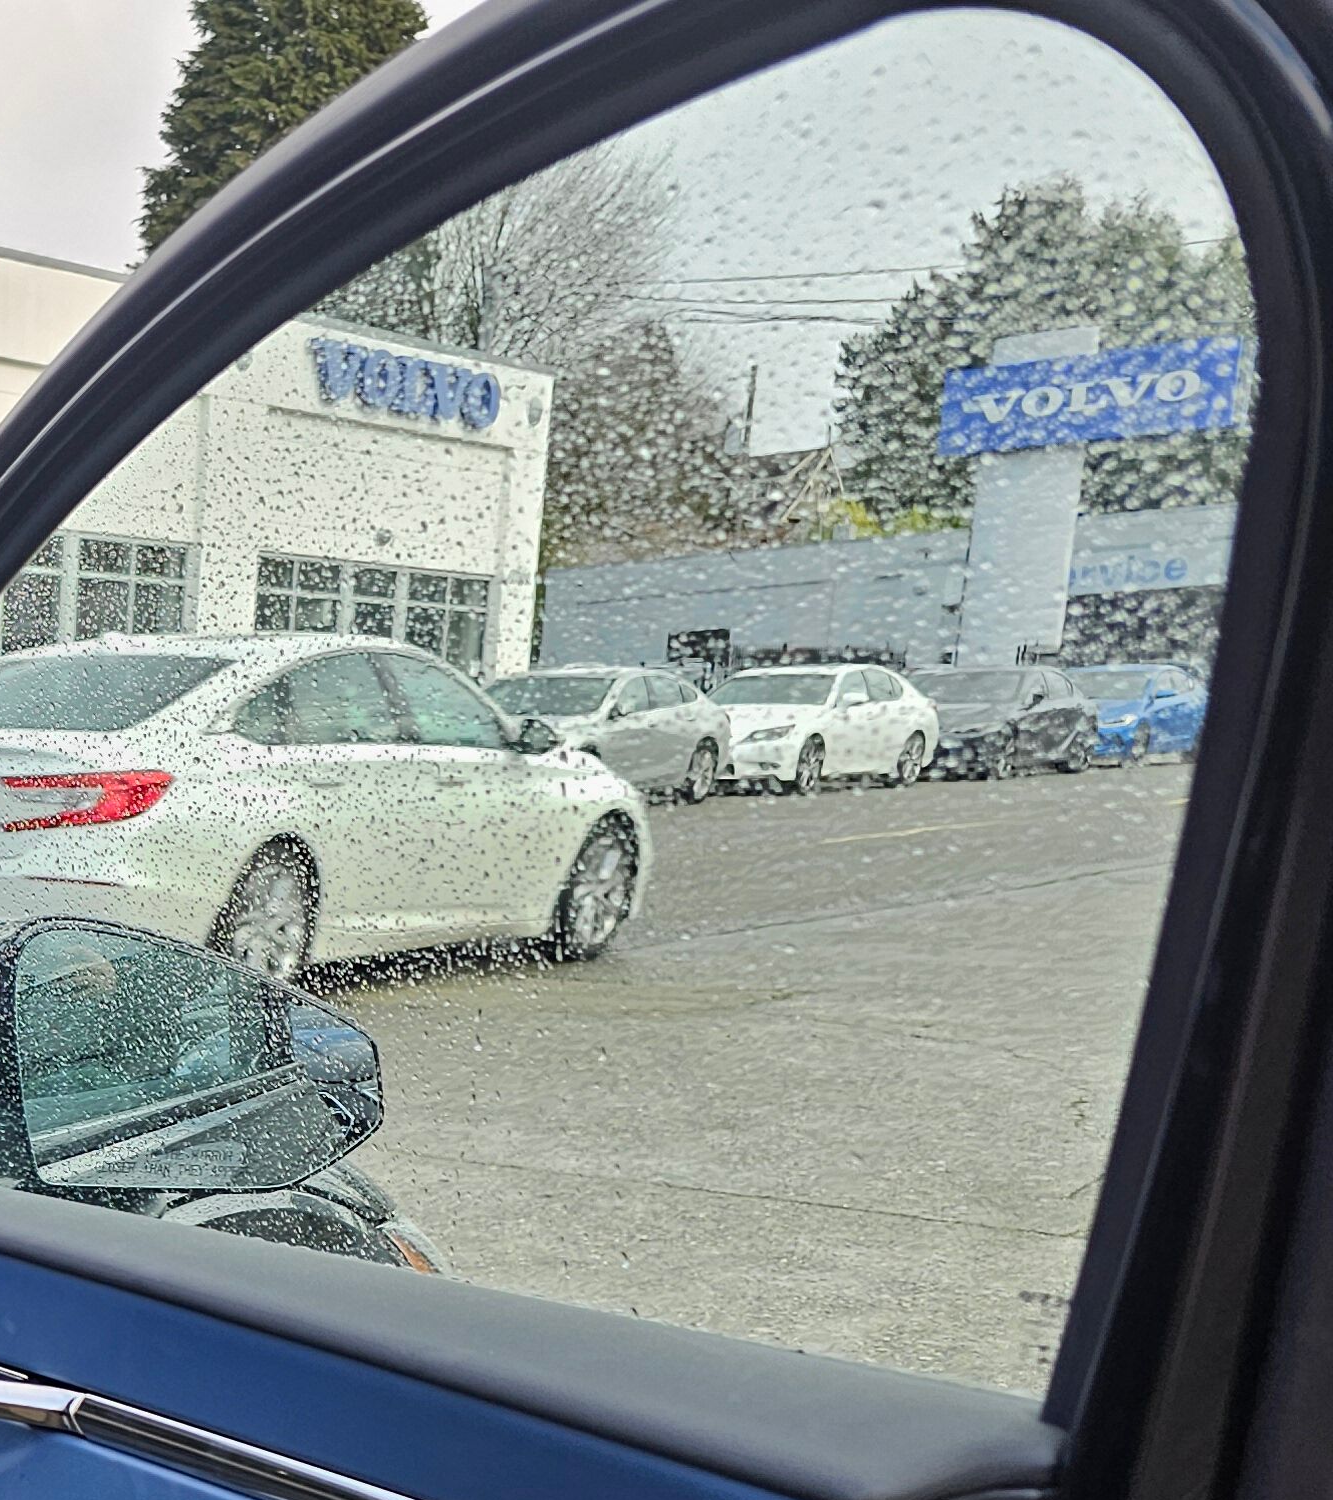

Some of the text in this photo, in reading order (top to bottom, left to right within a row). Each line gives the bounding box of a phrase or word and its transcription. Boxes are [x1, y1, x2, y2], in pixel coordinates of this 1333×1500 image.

[309, 337, 501, 429] VOLVO
[972, 370, 1201, 424] VOLVO
[1069, 555, 1187, 587] rvice
